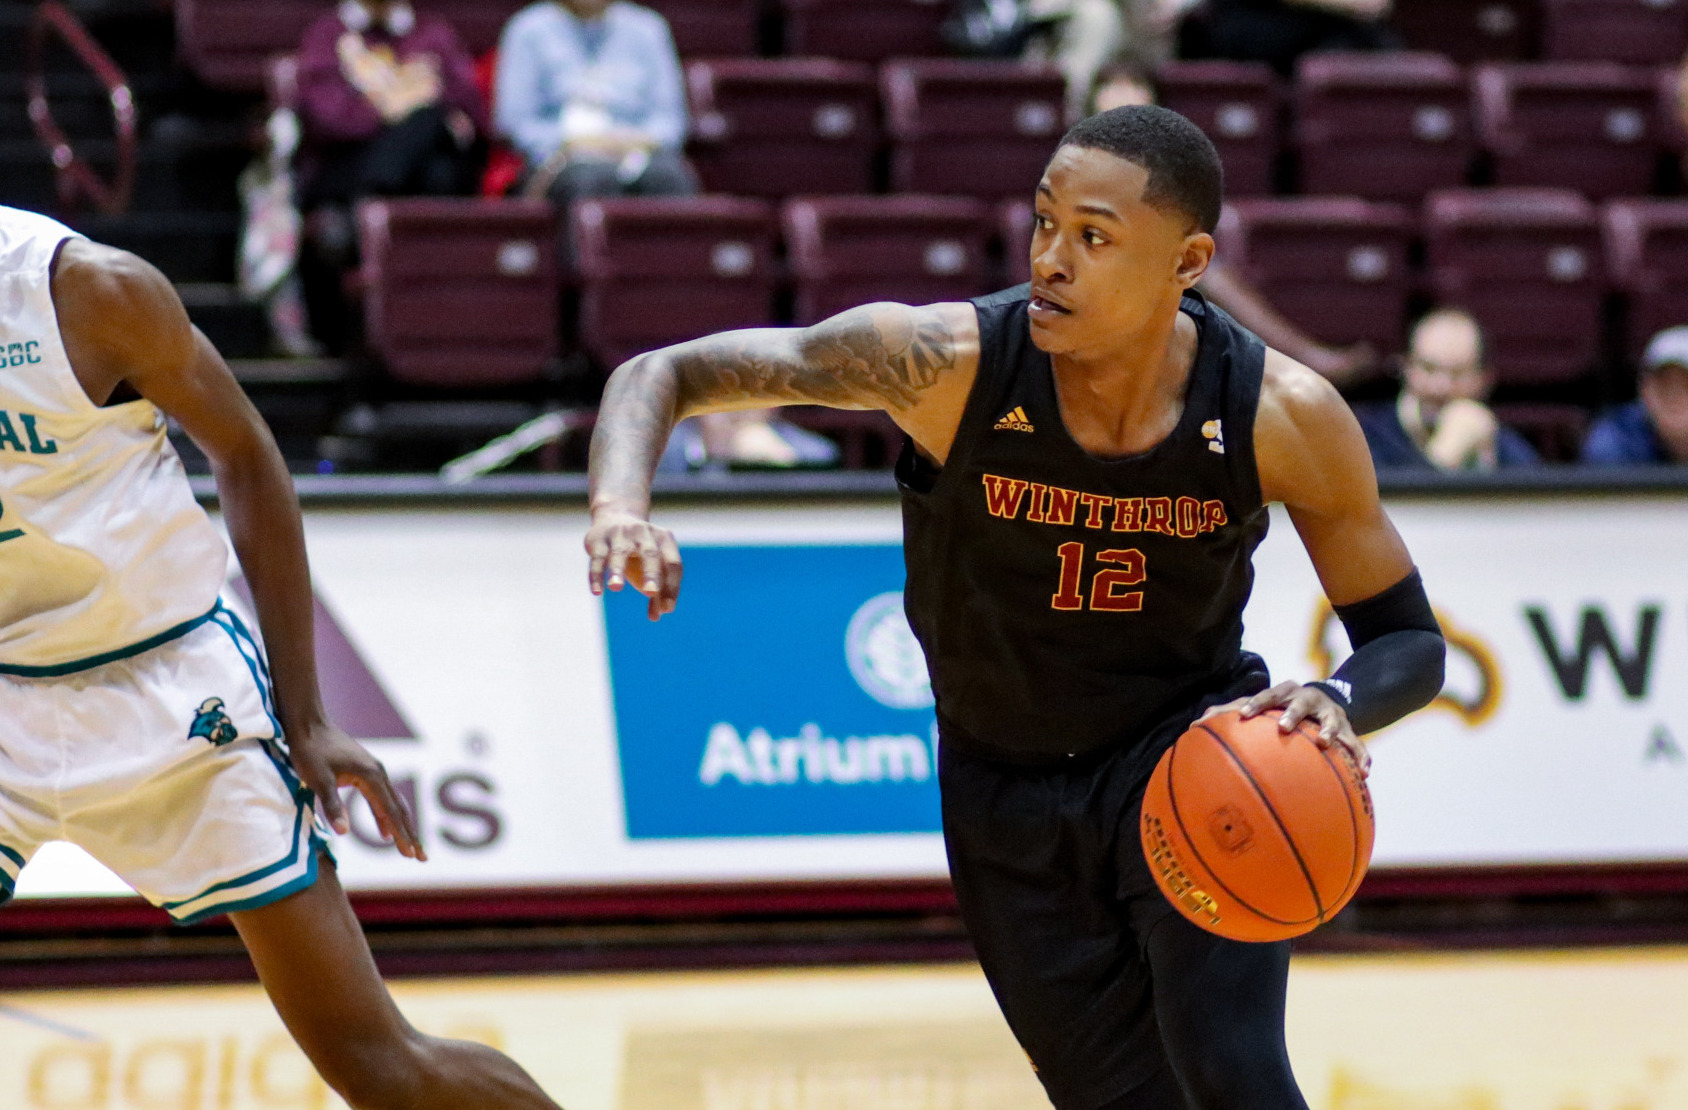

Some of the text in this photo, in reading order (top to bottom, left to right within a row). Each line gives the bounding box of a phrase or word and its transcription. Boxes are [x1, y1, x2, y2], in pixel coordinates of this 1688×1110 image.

[993, 421, 1035, 433] adidas
[982, 473, 1228, 538] WINTHROP
[1051, 541, 1147, 611] 12
[699, 721, 931, 786] Atrium
